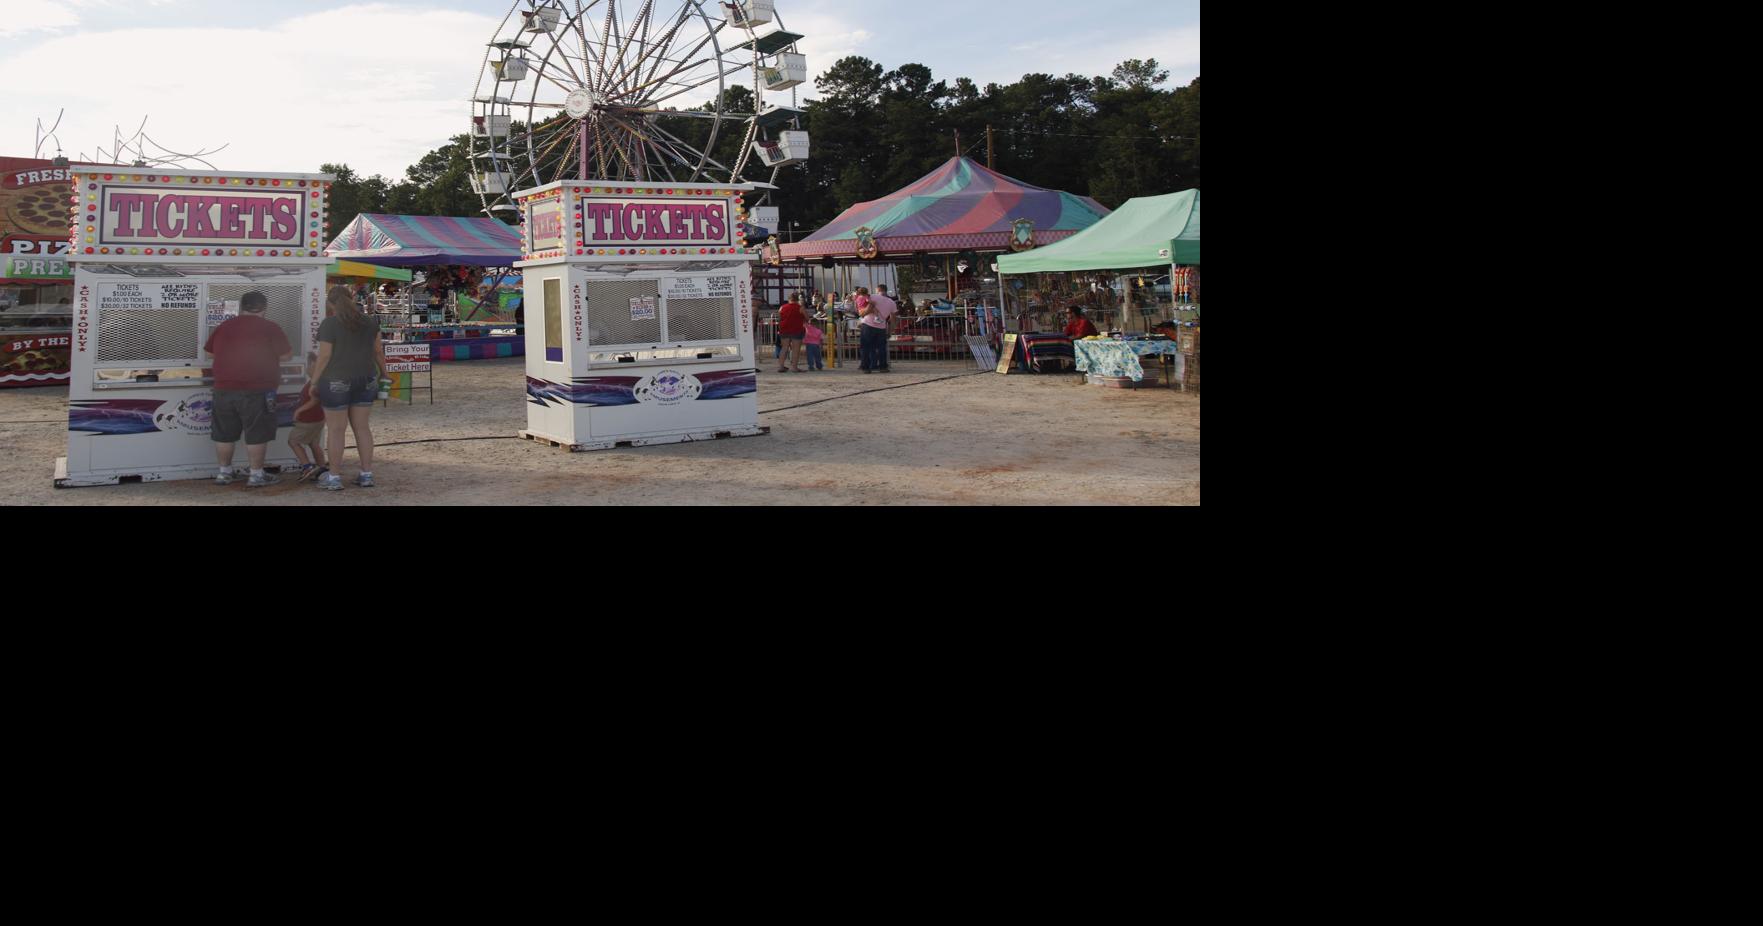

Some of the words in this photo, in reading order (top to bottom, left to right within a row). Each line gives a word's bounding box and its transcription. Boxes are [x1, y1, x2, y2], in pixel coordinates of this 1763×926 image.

[110, 193, 297, 240] TICKETS
[588, 203, 725, 240] TICKETS
[80, 290, 89, 314] CASH
[13, 340, 33, 350] BY
[39, 337, 69, 346] THE
[78, 322, 88, 346] ONLY
